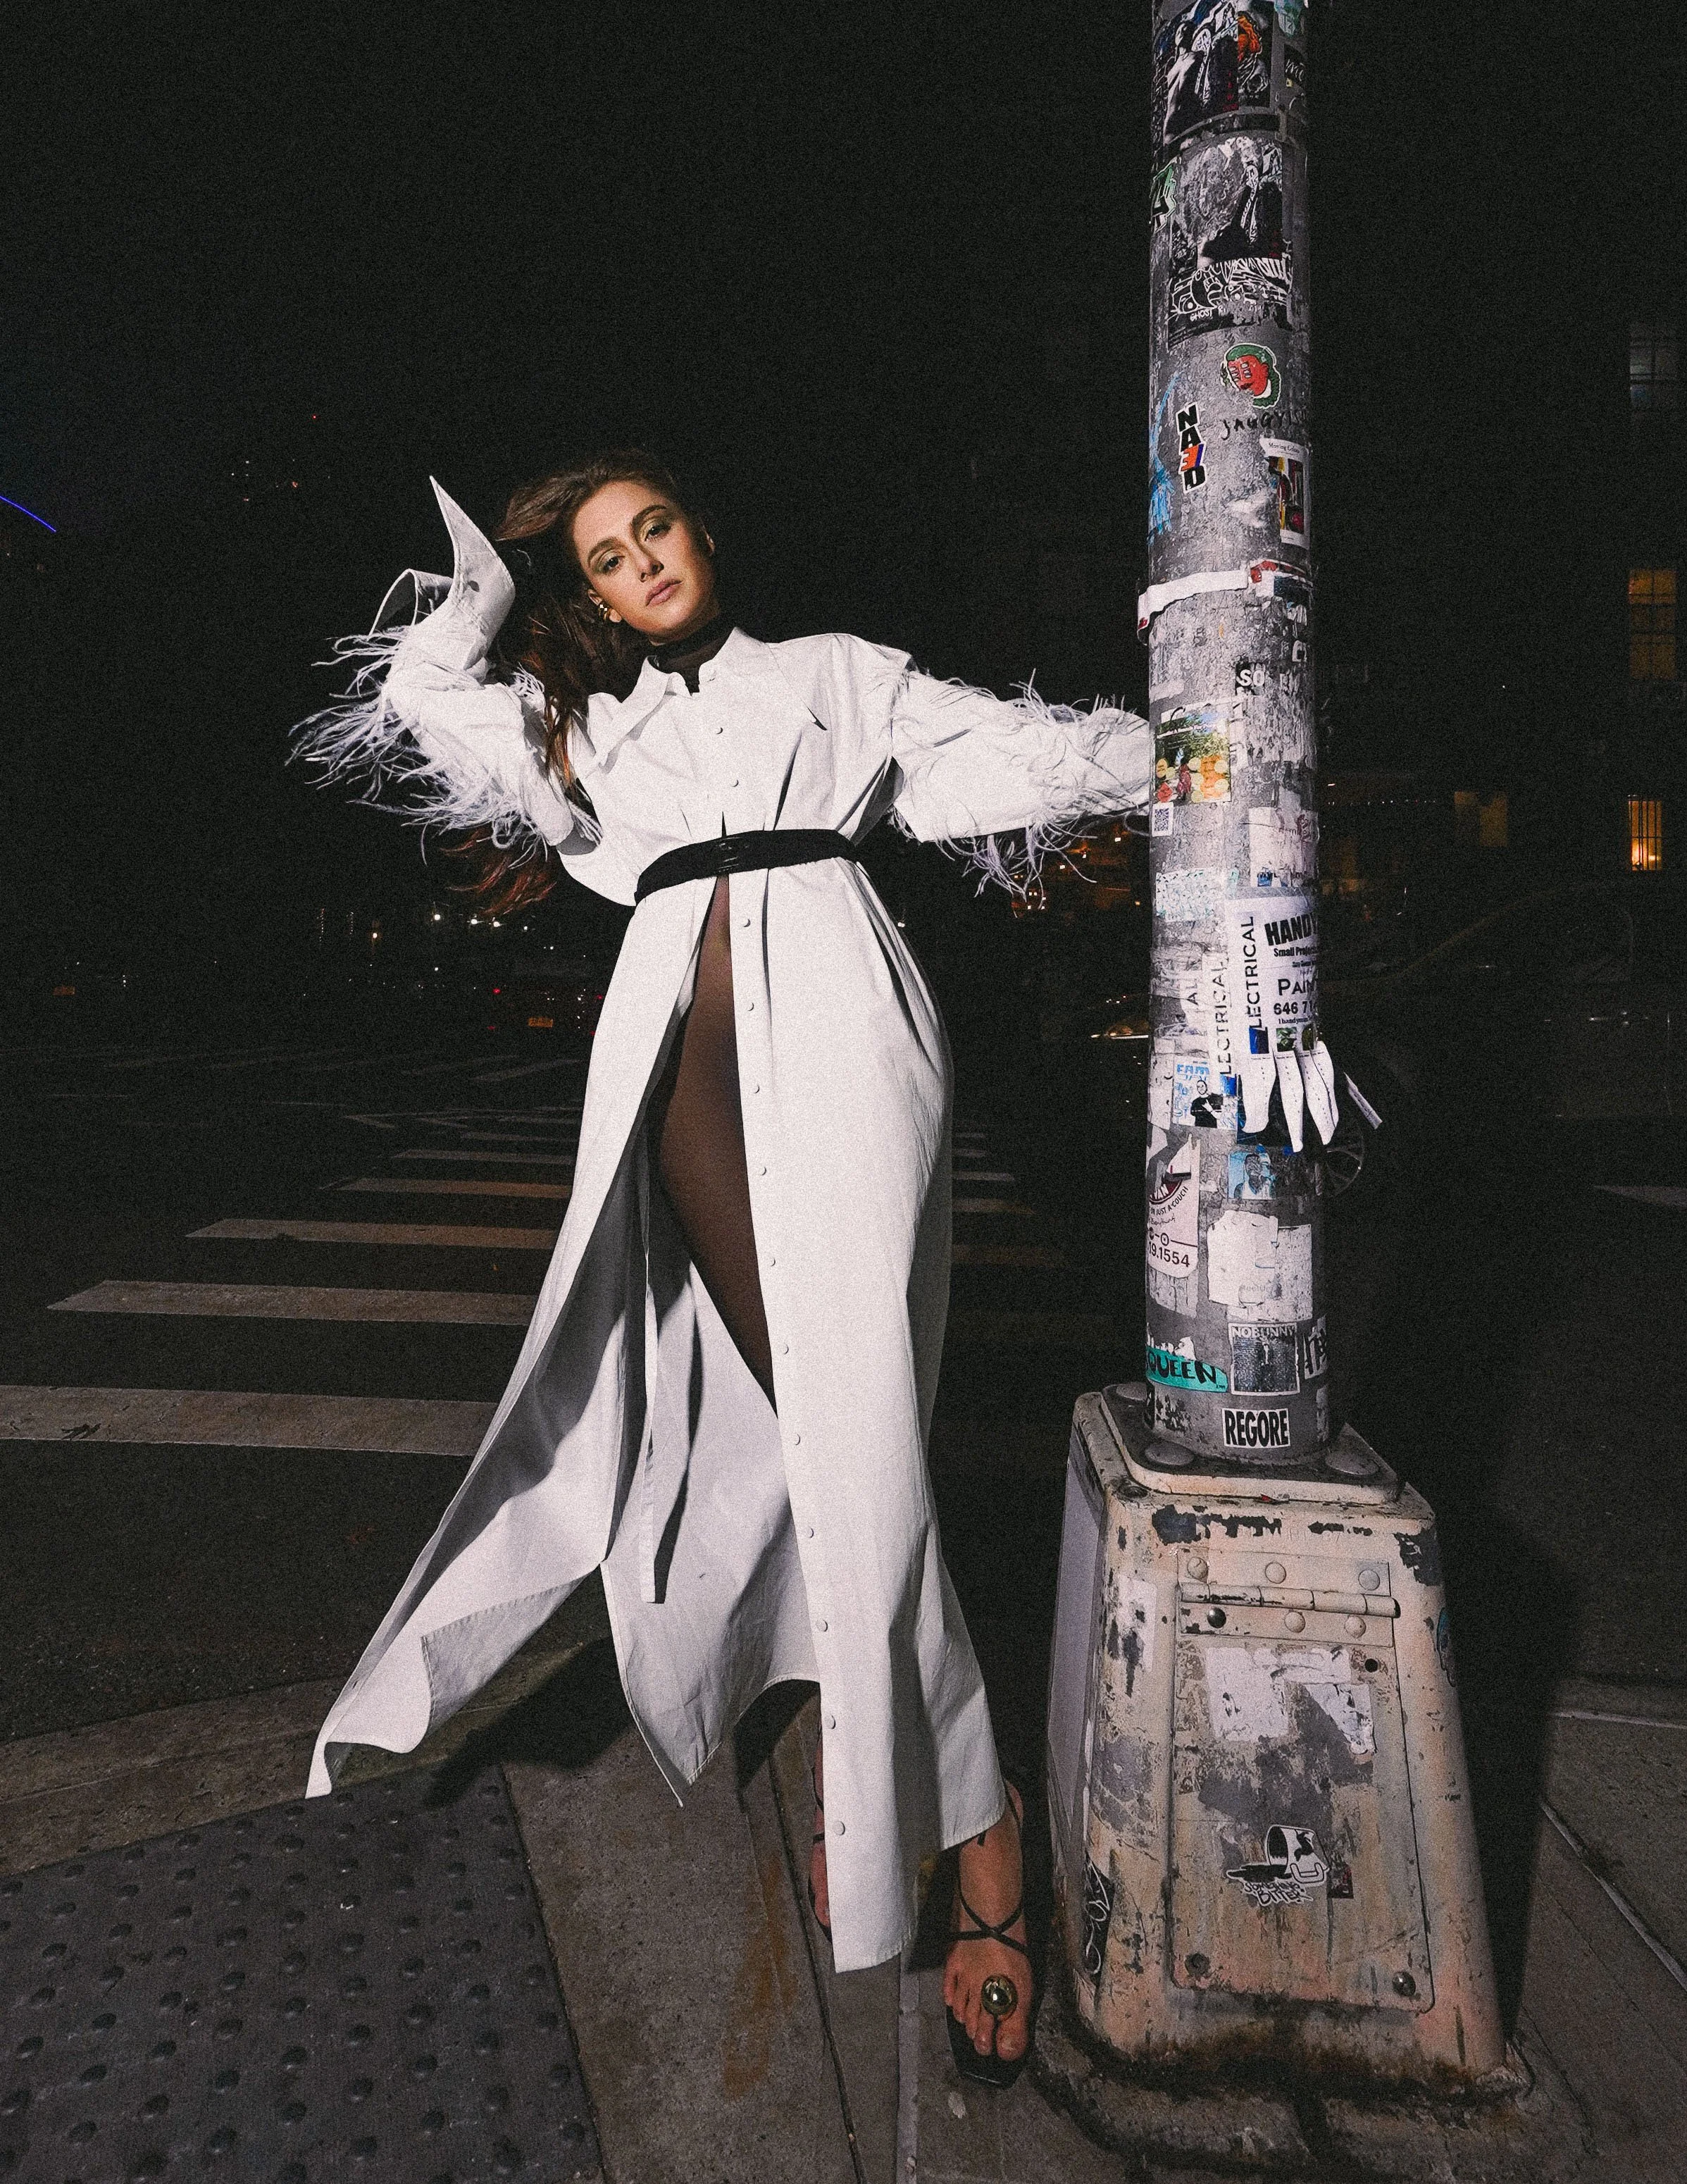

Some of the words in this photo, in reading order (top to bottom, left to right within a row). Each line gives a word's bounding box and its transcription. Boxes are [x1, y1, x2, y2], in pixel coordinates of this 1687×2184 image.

[1274, 946, 1295, 957] Small
[1274, 1001, 1299, 1015] 646
[1224, 1410, 1289, 1447] REGORE
